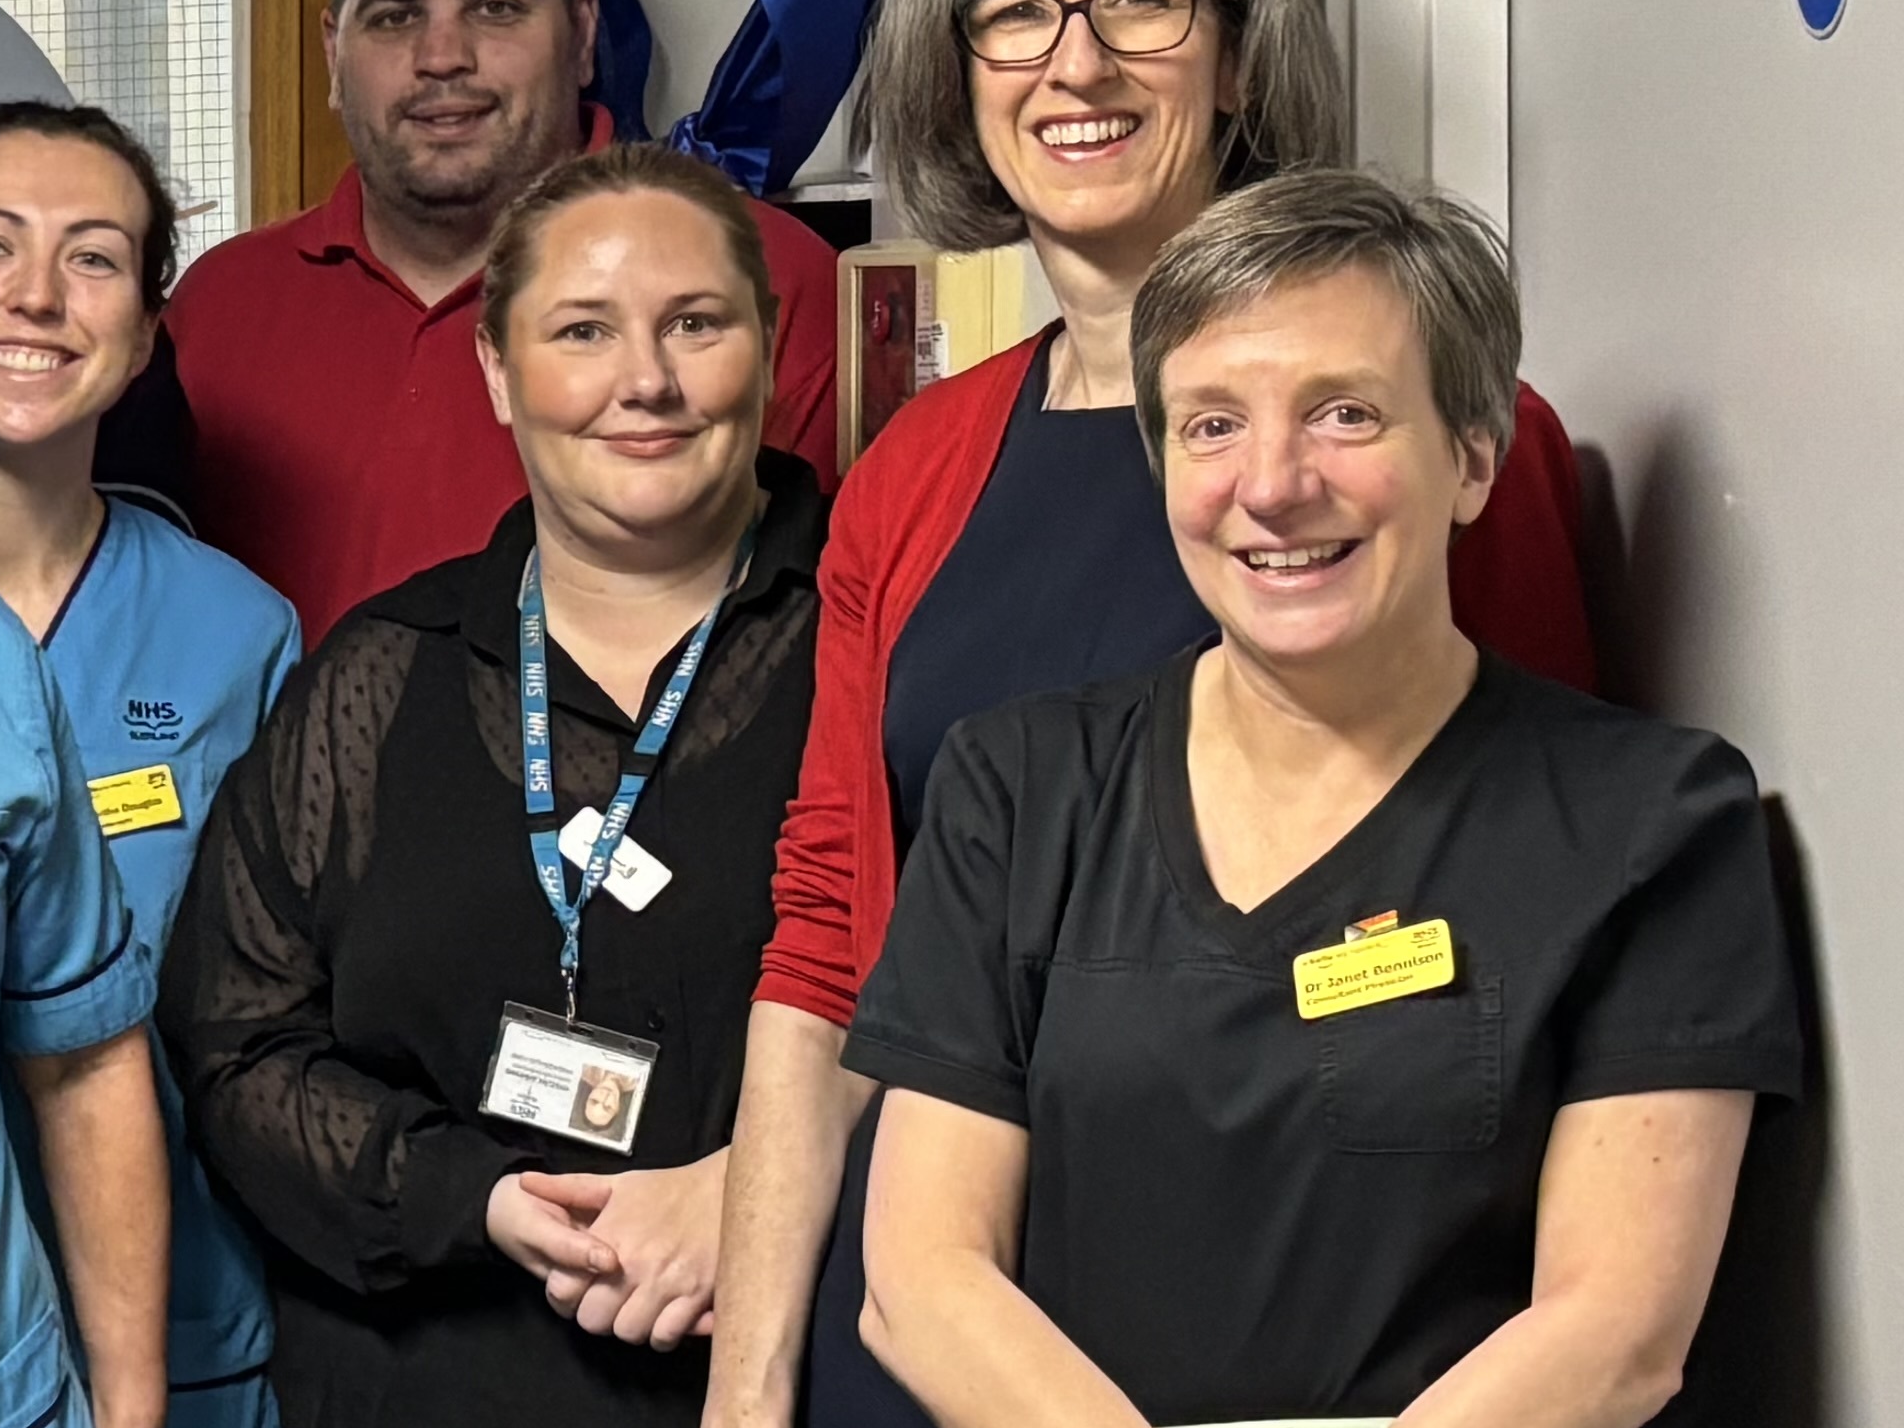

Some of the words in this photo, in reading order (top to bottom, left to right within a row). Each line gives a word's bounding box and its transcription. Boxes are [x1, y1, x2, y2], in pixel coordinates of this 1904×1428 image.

[525, 662, 544, 697] NHS
[128, 699, 177, 720] NHS
[652, 690, 682, 728] NHS
[527, 712, 547, 746] NHS
[529, 758, 548, 792] NHS
[1305, 982, 1323, 994] Dr
[1327, 970, 1369, 988] Janet
